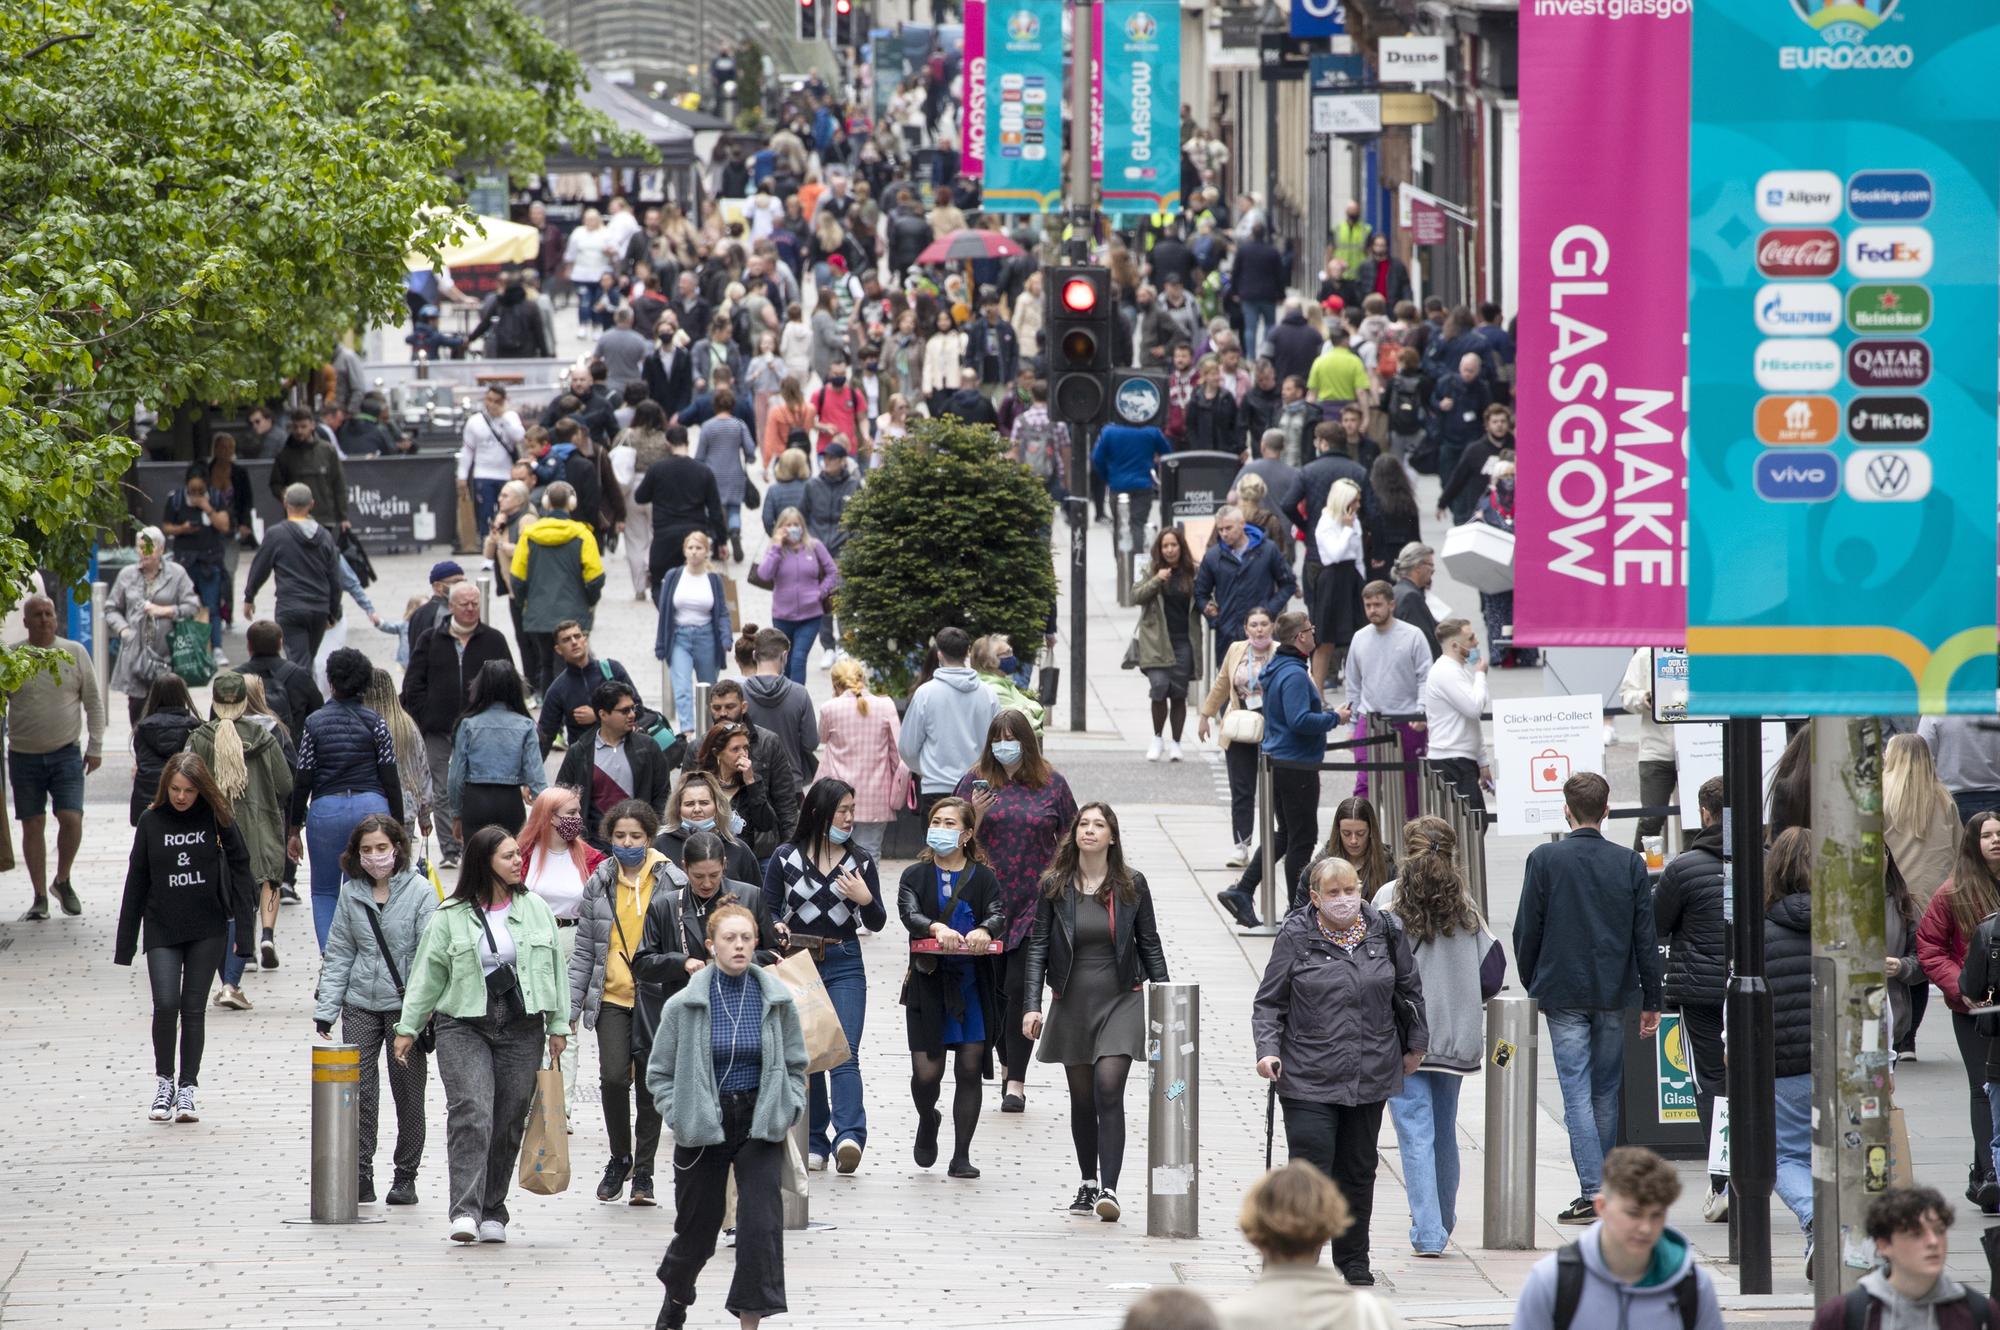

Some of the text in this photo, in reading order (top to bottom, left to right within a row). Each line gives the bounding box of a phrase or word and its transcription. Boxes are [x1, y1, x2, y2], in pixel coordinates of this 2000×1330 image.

[1386, 51, 1439, 63] Dune
[969, 57, 987, 161] GLASGOW
[1131, 61, 1152, 161] GLASGOW
[1786, 190, 1831, 205] Alipay
[1851, 188, 1931, 205] Booking.com
[1857, 242, 1921, 262] FedEx
[1855, 311, 1923, 326] Heineken
[1761, 358, 1835, 371] Hisense
[1854, 349, 1922, 370] QATAR
[1870, 368, 1923, 378] AIRWAYS
[1548, 224, 1609, 586] GLASGOW
[1871, 414, 1925, 430] TikTok
[1770, 467, 1826, 483] vivo
[1613, 387, 1675, 586] MAKE
[1503, 711, 1593, 725] Click-and-Collect
[164, 831, 206, 846] ROCK
[177, 852, 191, 866] &
[168, 871, 206, 887] ROLL
